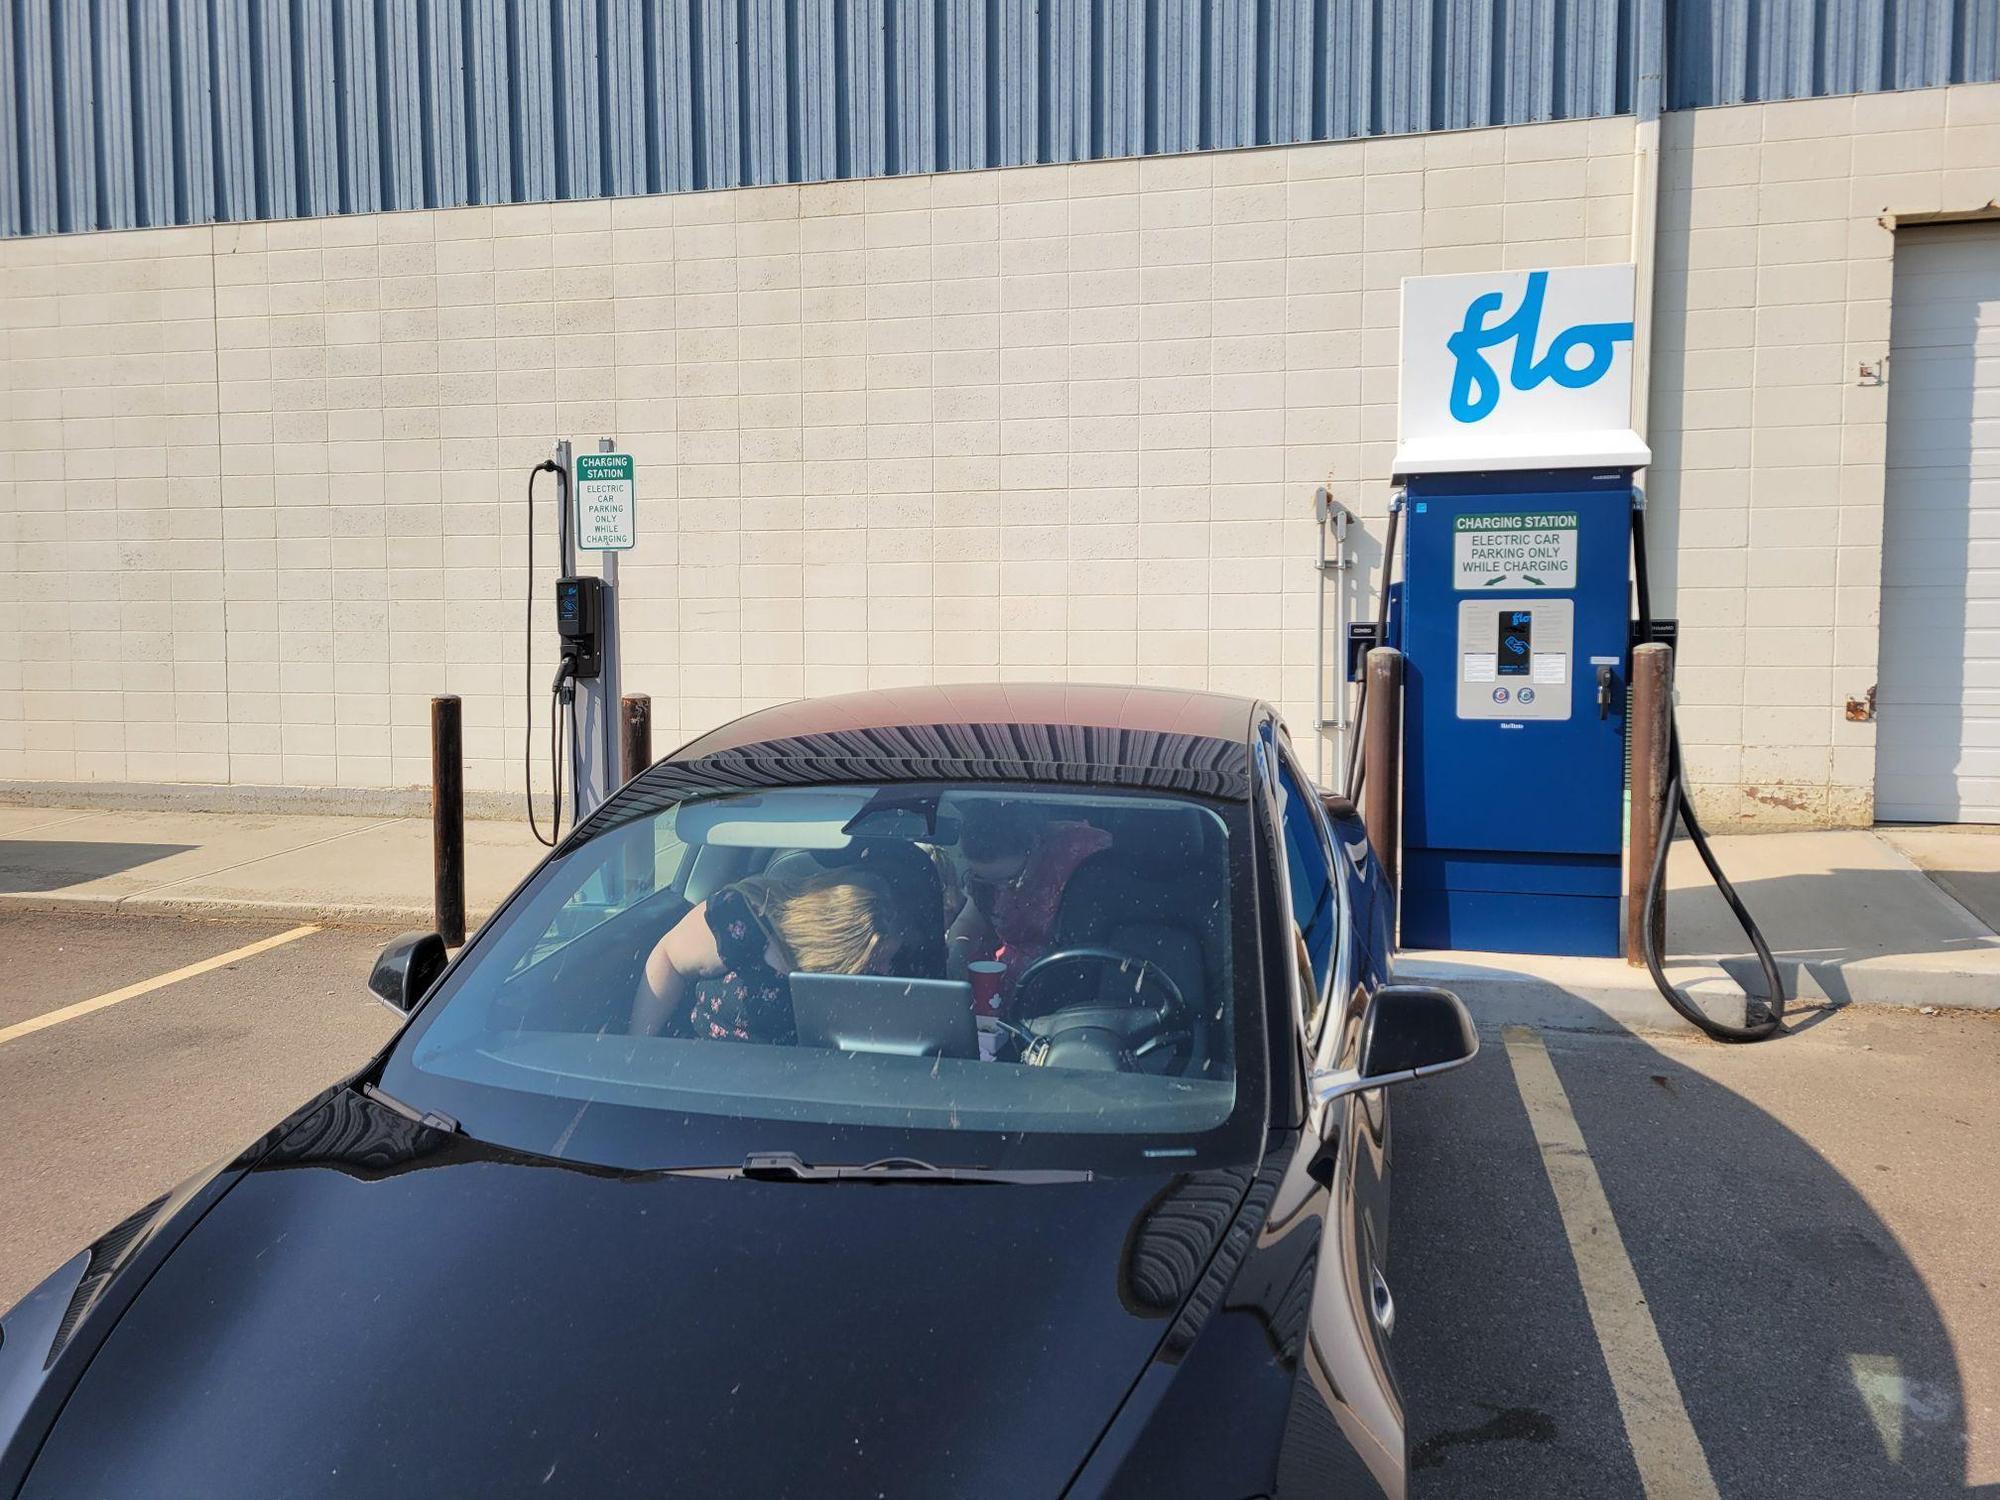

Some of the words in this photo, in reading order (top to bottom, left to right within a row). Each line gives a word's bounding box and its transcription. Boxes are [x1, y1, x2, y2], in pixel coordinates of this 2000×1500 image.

[1446, 271, 1634, 423] flo
[582, 457, 628, 467] CHARGING
[587, 469, 624, 479] STATION
[587, 485, 624, 493] ELECTRIC
[597, 495, 614, 503] CAR
[588, 505, 624, 513] PARKING
[595, 515, 617, 523] ONLY
[1456, 516, 1522, 530] CHARGING
[1525, 515, 1577, 528] STATION
[594, 525, 618, 533] WHILE
[586, 535, 627, 543] CHARGING
[1471, 533, 1530, 546] ELECTRIC
[1534, 533, 1560, 545] CAR
[1471, 547, 1525, 560] PARKING
[1528, 547, 1560, 559] ONLY
[1462, 561, 1500, 572] WHILE
[1503, 560, 1569, 572] CHARGING
[1511, 611, 1532, 626] flo
